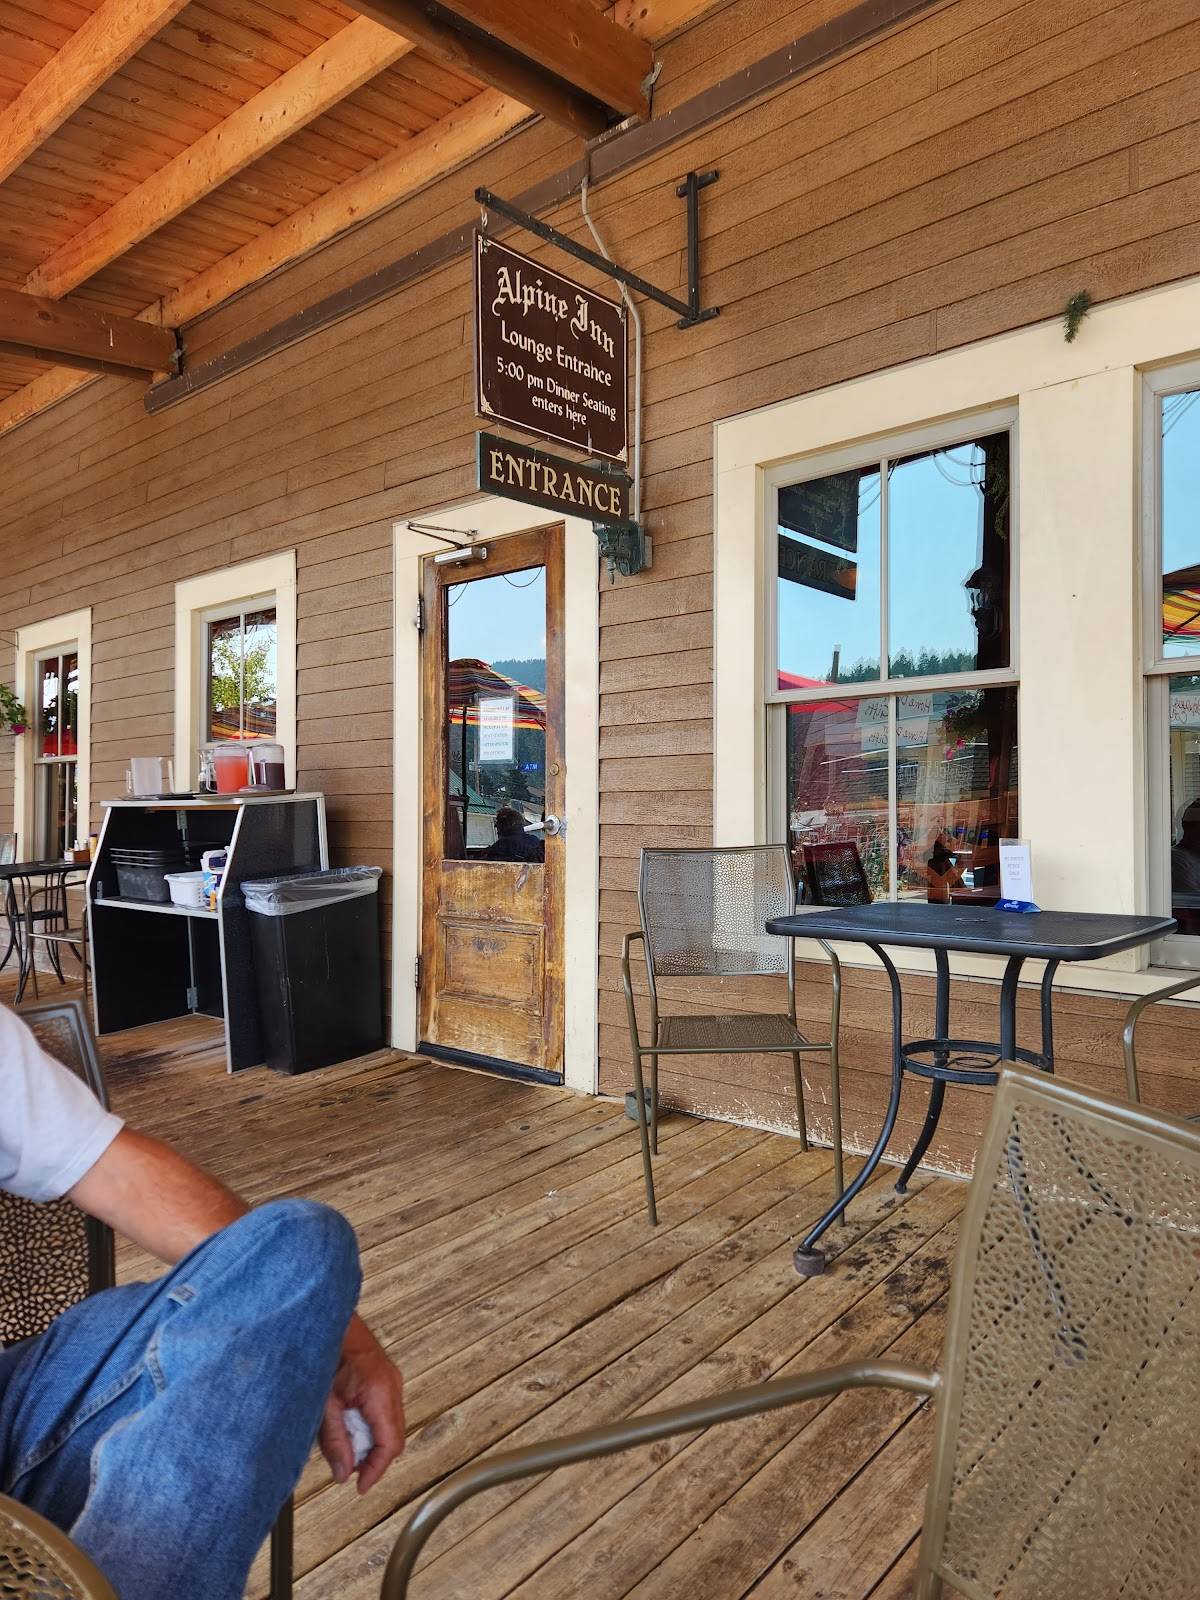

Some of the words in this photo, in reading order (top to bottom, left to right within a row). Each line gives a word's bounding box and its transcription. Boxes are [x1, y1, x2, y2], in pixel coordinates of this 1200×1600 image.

[492, 266, 568, 322] Alpine
[570, 294, 615, 358] Inn
[501, 320, 552, 363] Lounge
[556, 345, 612, 386] Entrance
[497, 357, 524, 381] 5:00
[527, 372, 544, 390] pm
[547, 377, 580, 403] Dinner
[582, 392, 617, 422] Seating
[532, 394, 563, 417] enters
[566, 404, 587, 425] here
[489, 449, 622, 516] ENTRANCE
